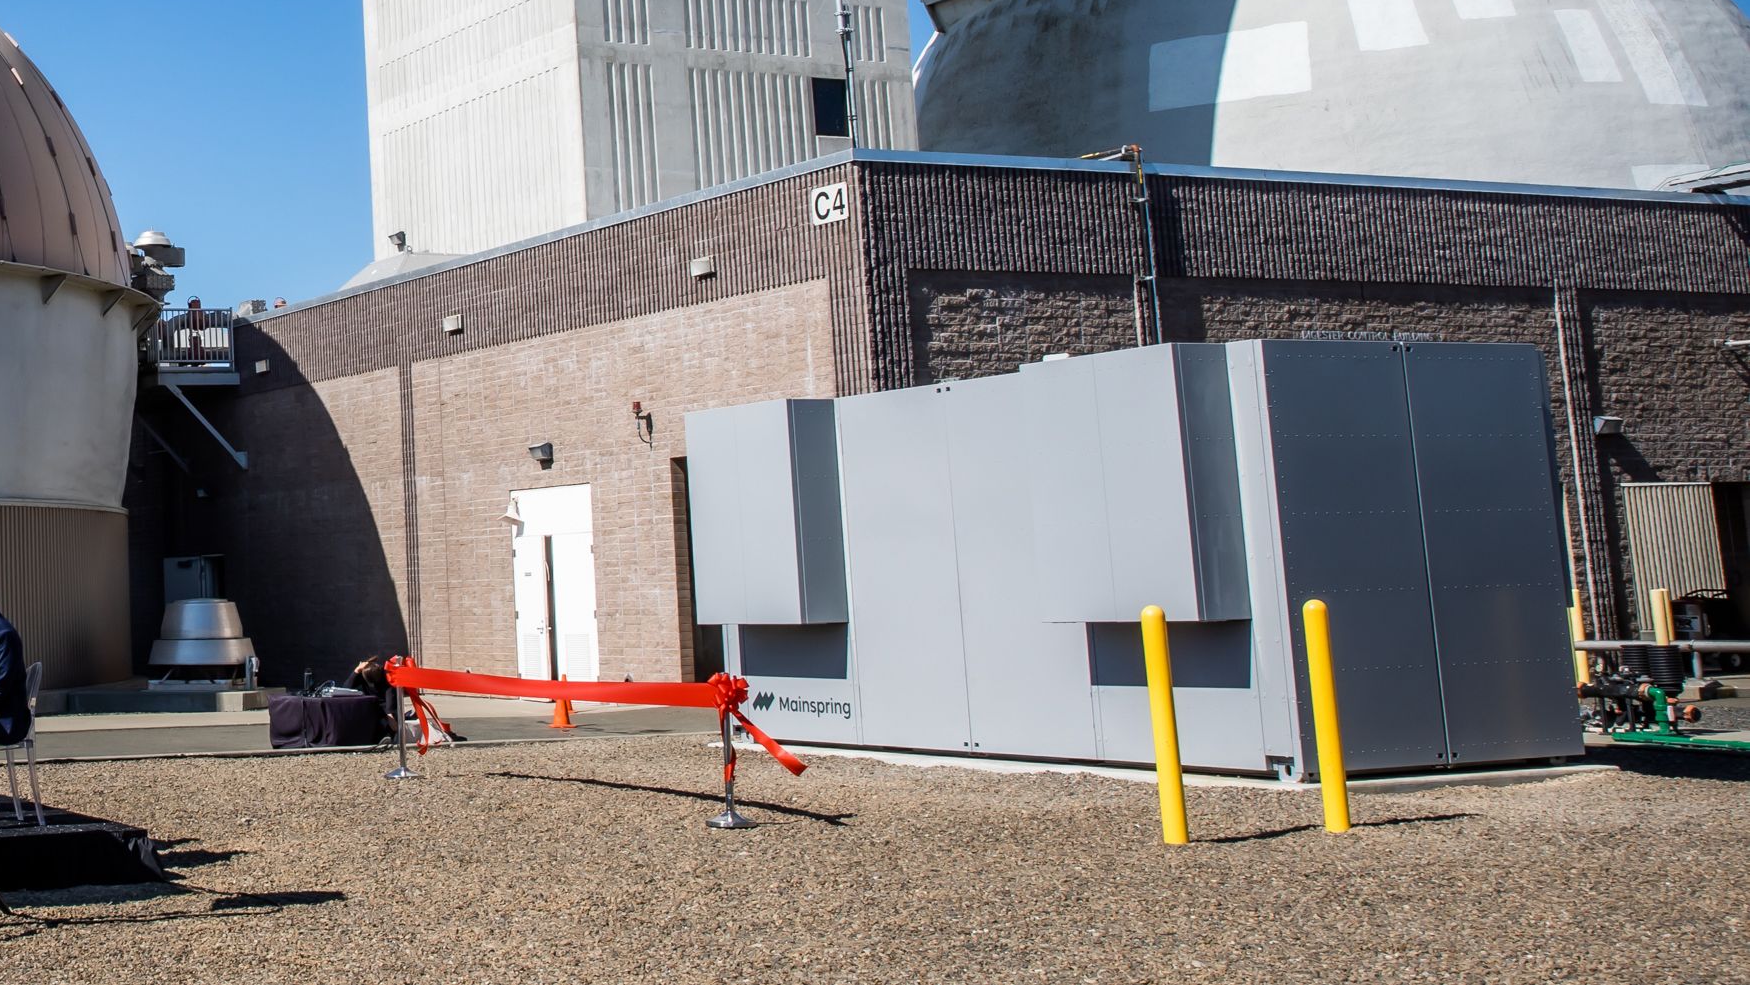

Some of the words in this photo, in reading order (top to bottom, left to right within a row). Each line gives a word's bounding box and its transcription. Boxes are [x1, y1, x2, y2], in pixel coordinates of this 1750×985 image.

[815, 188, 845, 220] C4
[1301, 330, 1345, 340] DIGESTER
[1347, 330, 1390, 341] CONTROL
[779, 696, 851, 720] Mainspring
